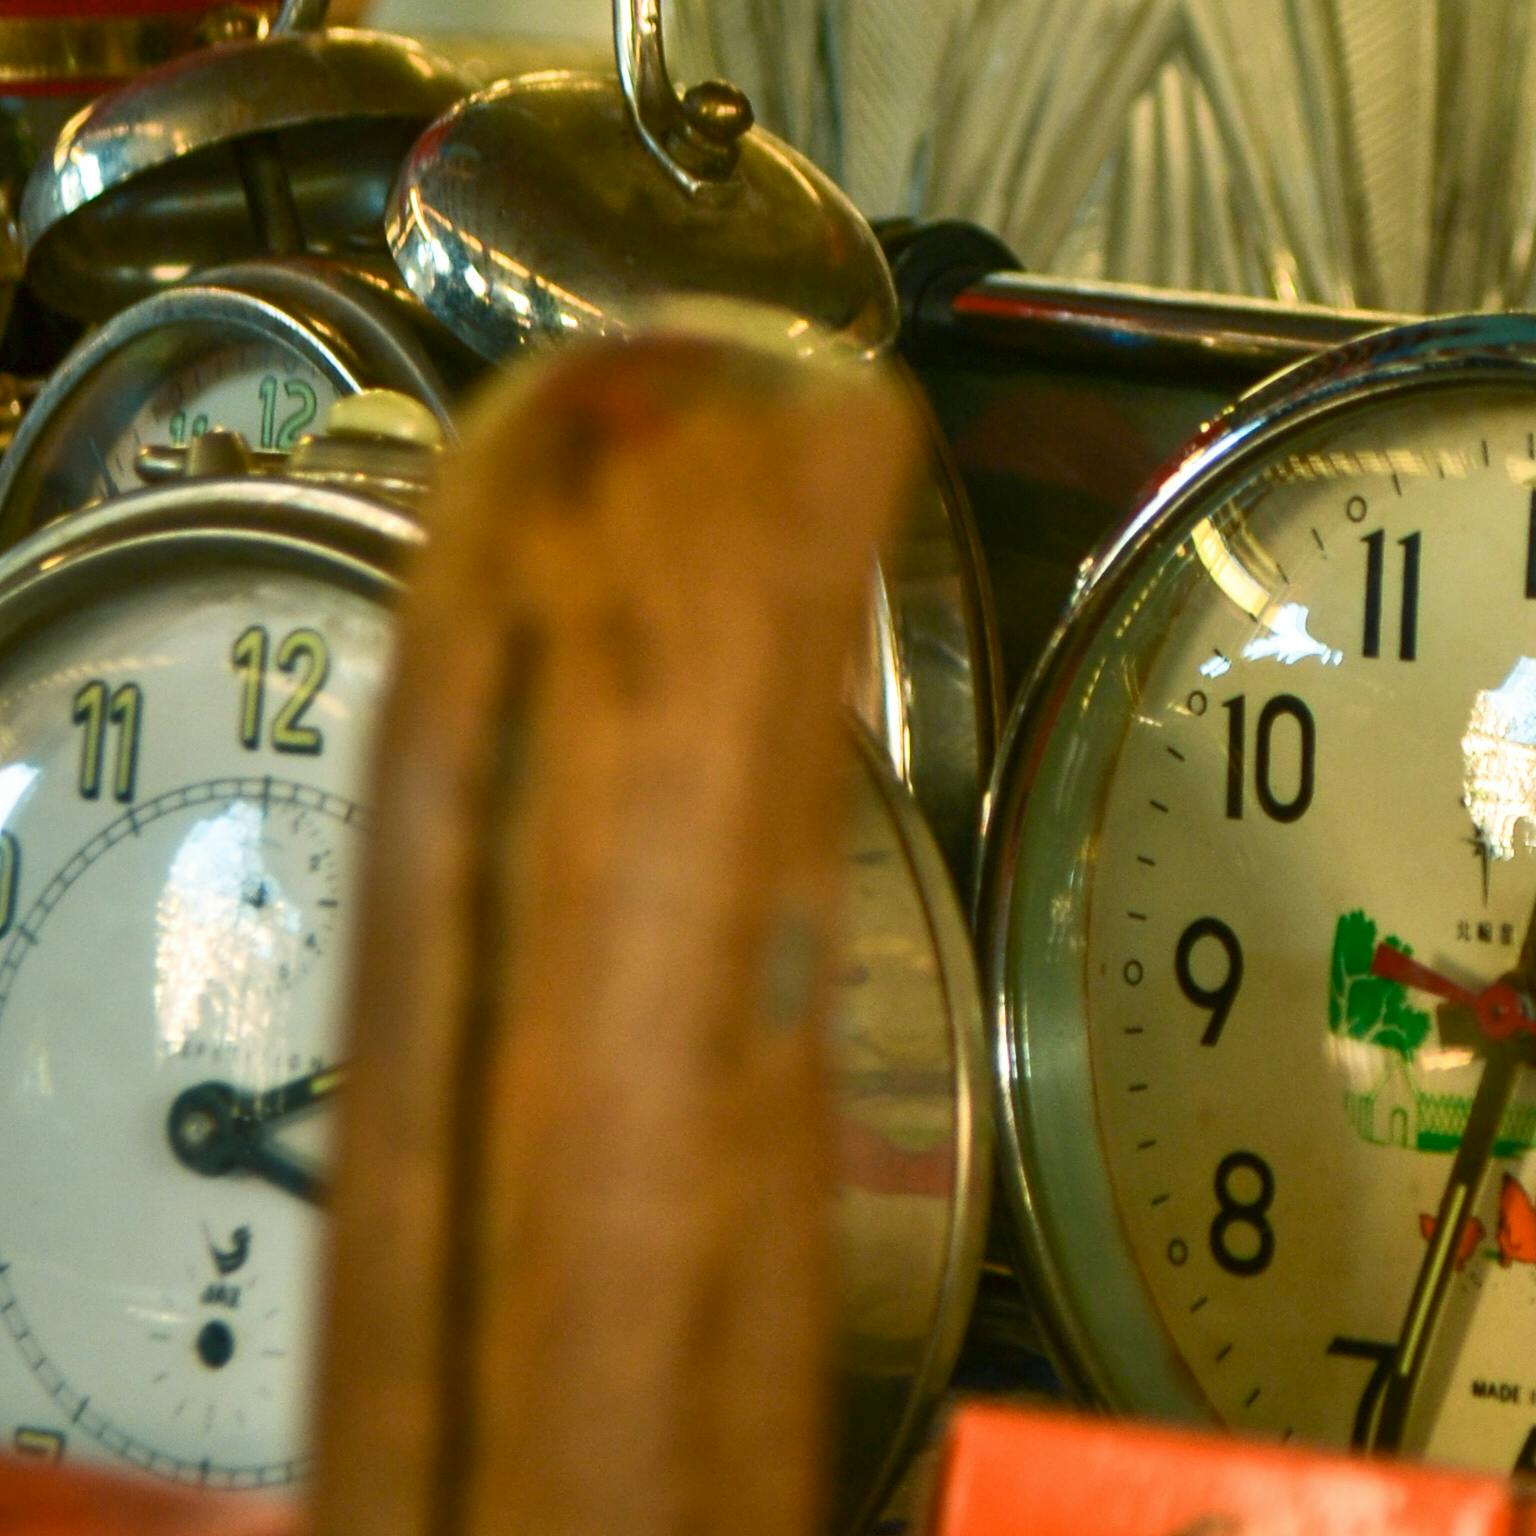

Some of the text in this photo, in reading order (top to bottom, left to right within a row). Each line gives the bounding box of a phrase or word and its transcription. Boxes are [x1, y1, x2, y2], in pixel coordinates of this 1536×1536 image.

[258, 374, 317, 451] 12
[1360, 528, 1420, 661] 11
[72, 678, 144, 804] 11
[232, 625, 331, 756] 12
[1221, 694, 1316, 822] 10
[1175, 917, 1245, 1046] 9
[1209, 1152, 1276, 1276] 8
[1326, 1337, 1397, 1454] 7
[1472, 1380, 1520, 1404] MADE
